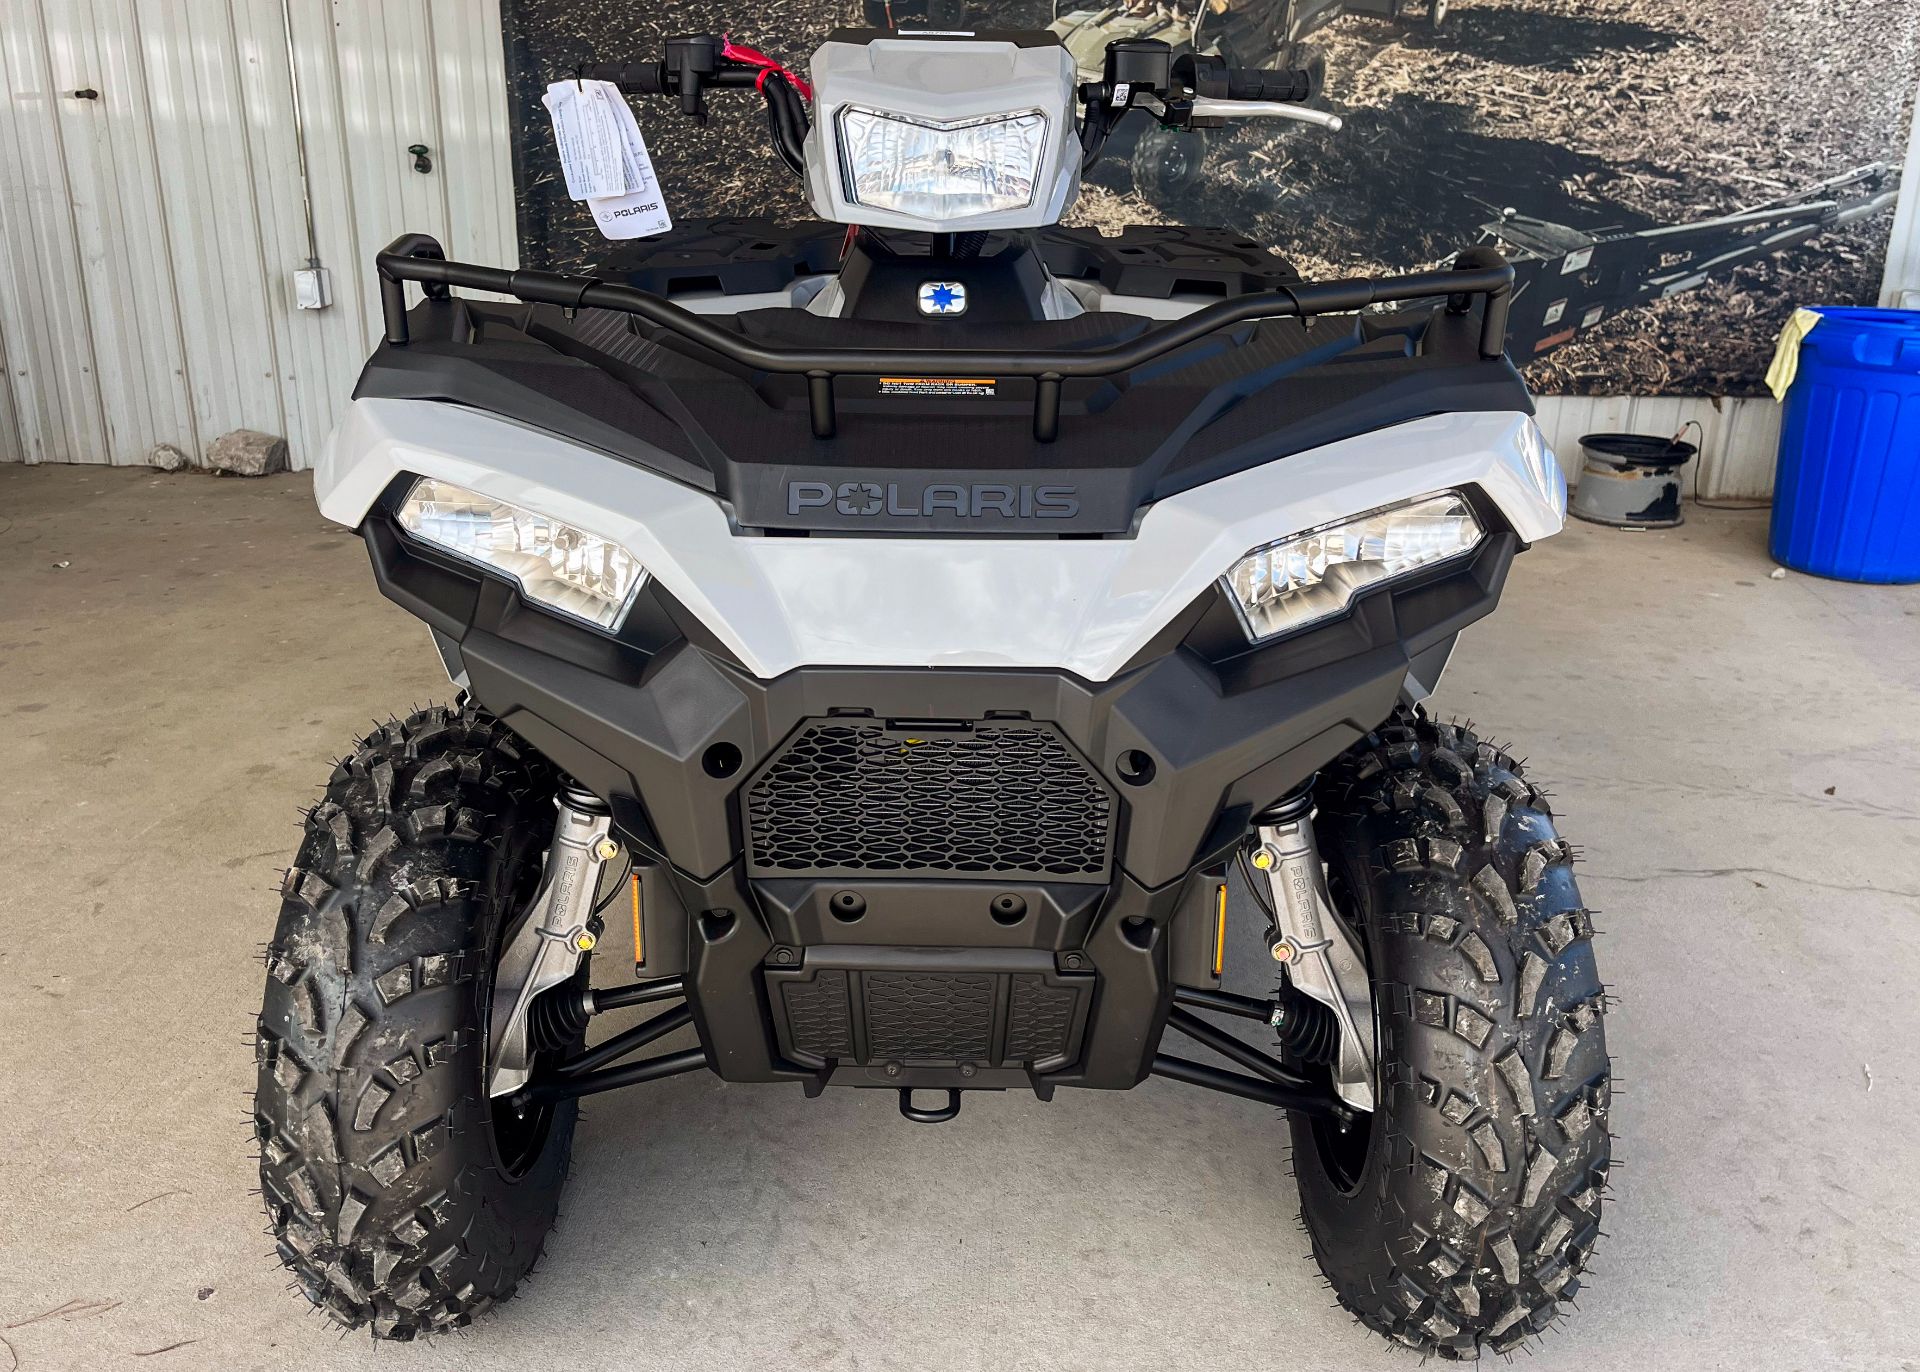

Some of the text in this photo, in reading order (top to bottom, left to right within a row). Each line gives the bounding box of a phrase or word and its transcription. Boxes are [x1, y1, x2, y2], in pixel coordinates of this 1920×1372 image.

[614, 202, 659, 218] POLARIS
[787, 480, 1080, 519] POLARIS
[552, 856, 578, 927] POLARIS
[1291, 865, 1317, 938] POLARIS
